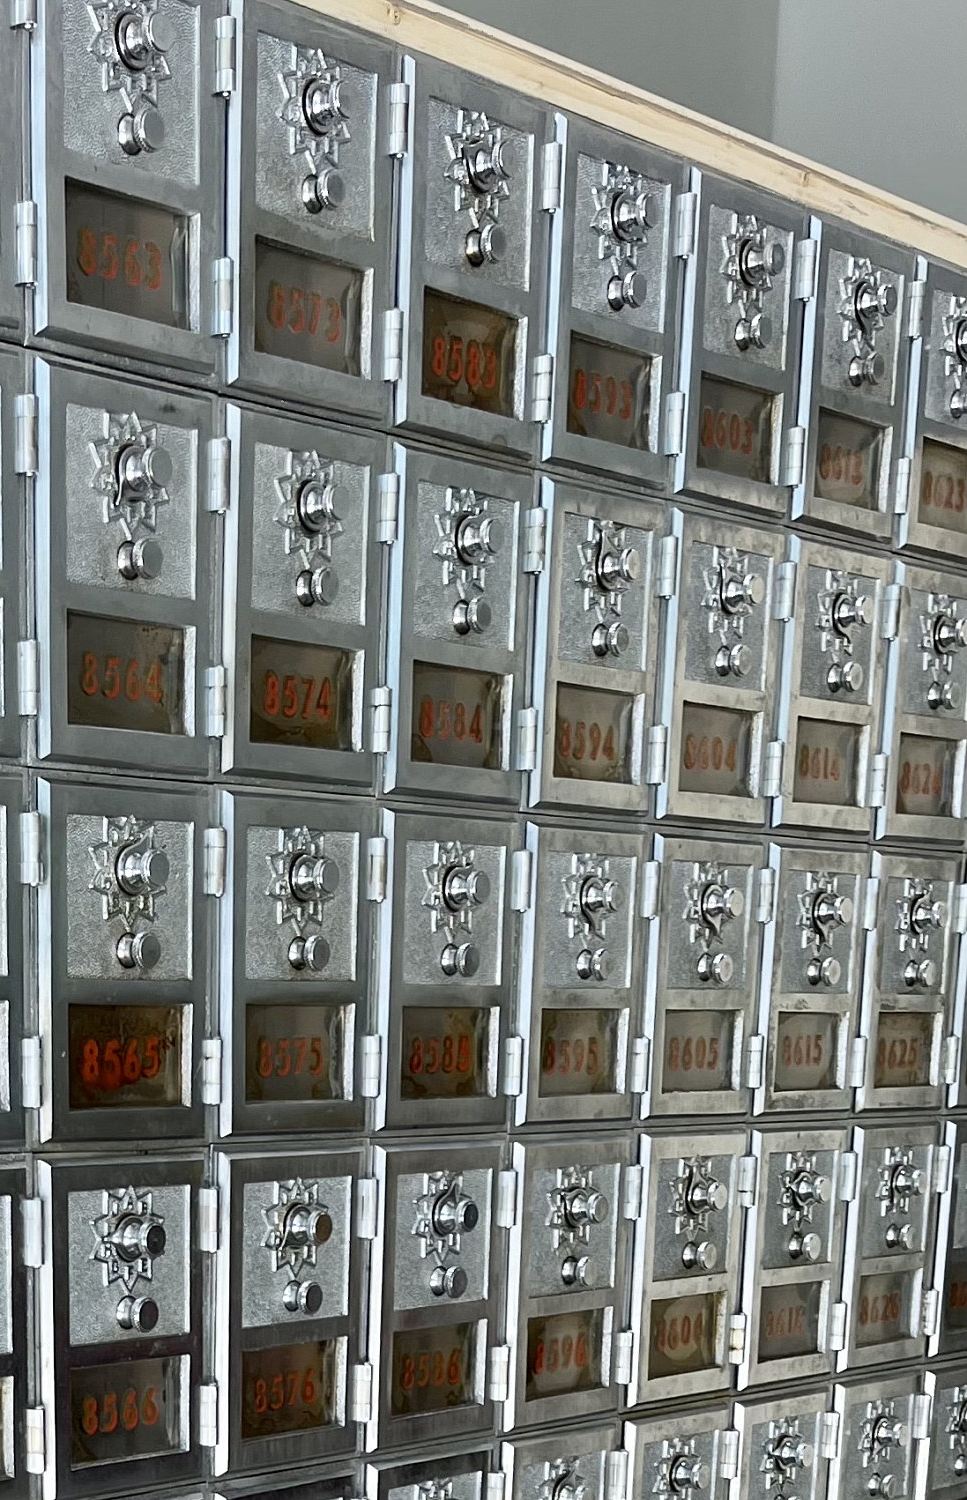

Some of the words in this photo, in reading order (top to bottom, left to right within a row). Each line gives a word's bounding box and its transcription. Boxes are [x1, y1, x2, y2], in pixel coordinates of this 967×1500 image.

[78, 226, 162, 289] 8563
[267, 279, 343, 343] 8573
[431, 335, 497, 389] 8583
[85, 650, 165, 704] 8564
[263, 674, 332, 720] 8574
[79, 1036, 163, 1084] 8565
[257, 1035, 324, 1078] 8575
[408, 1035, 470, 1075] 8585
[400, 1348, 463, 1391] 8586
[81, 1388, 160, 1436] 8566
[253, 1377, 316, 1413] 8576
